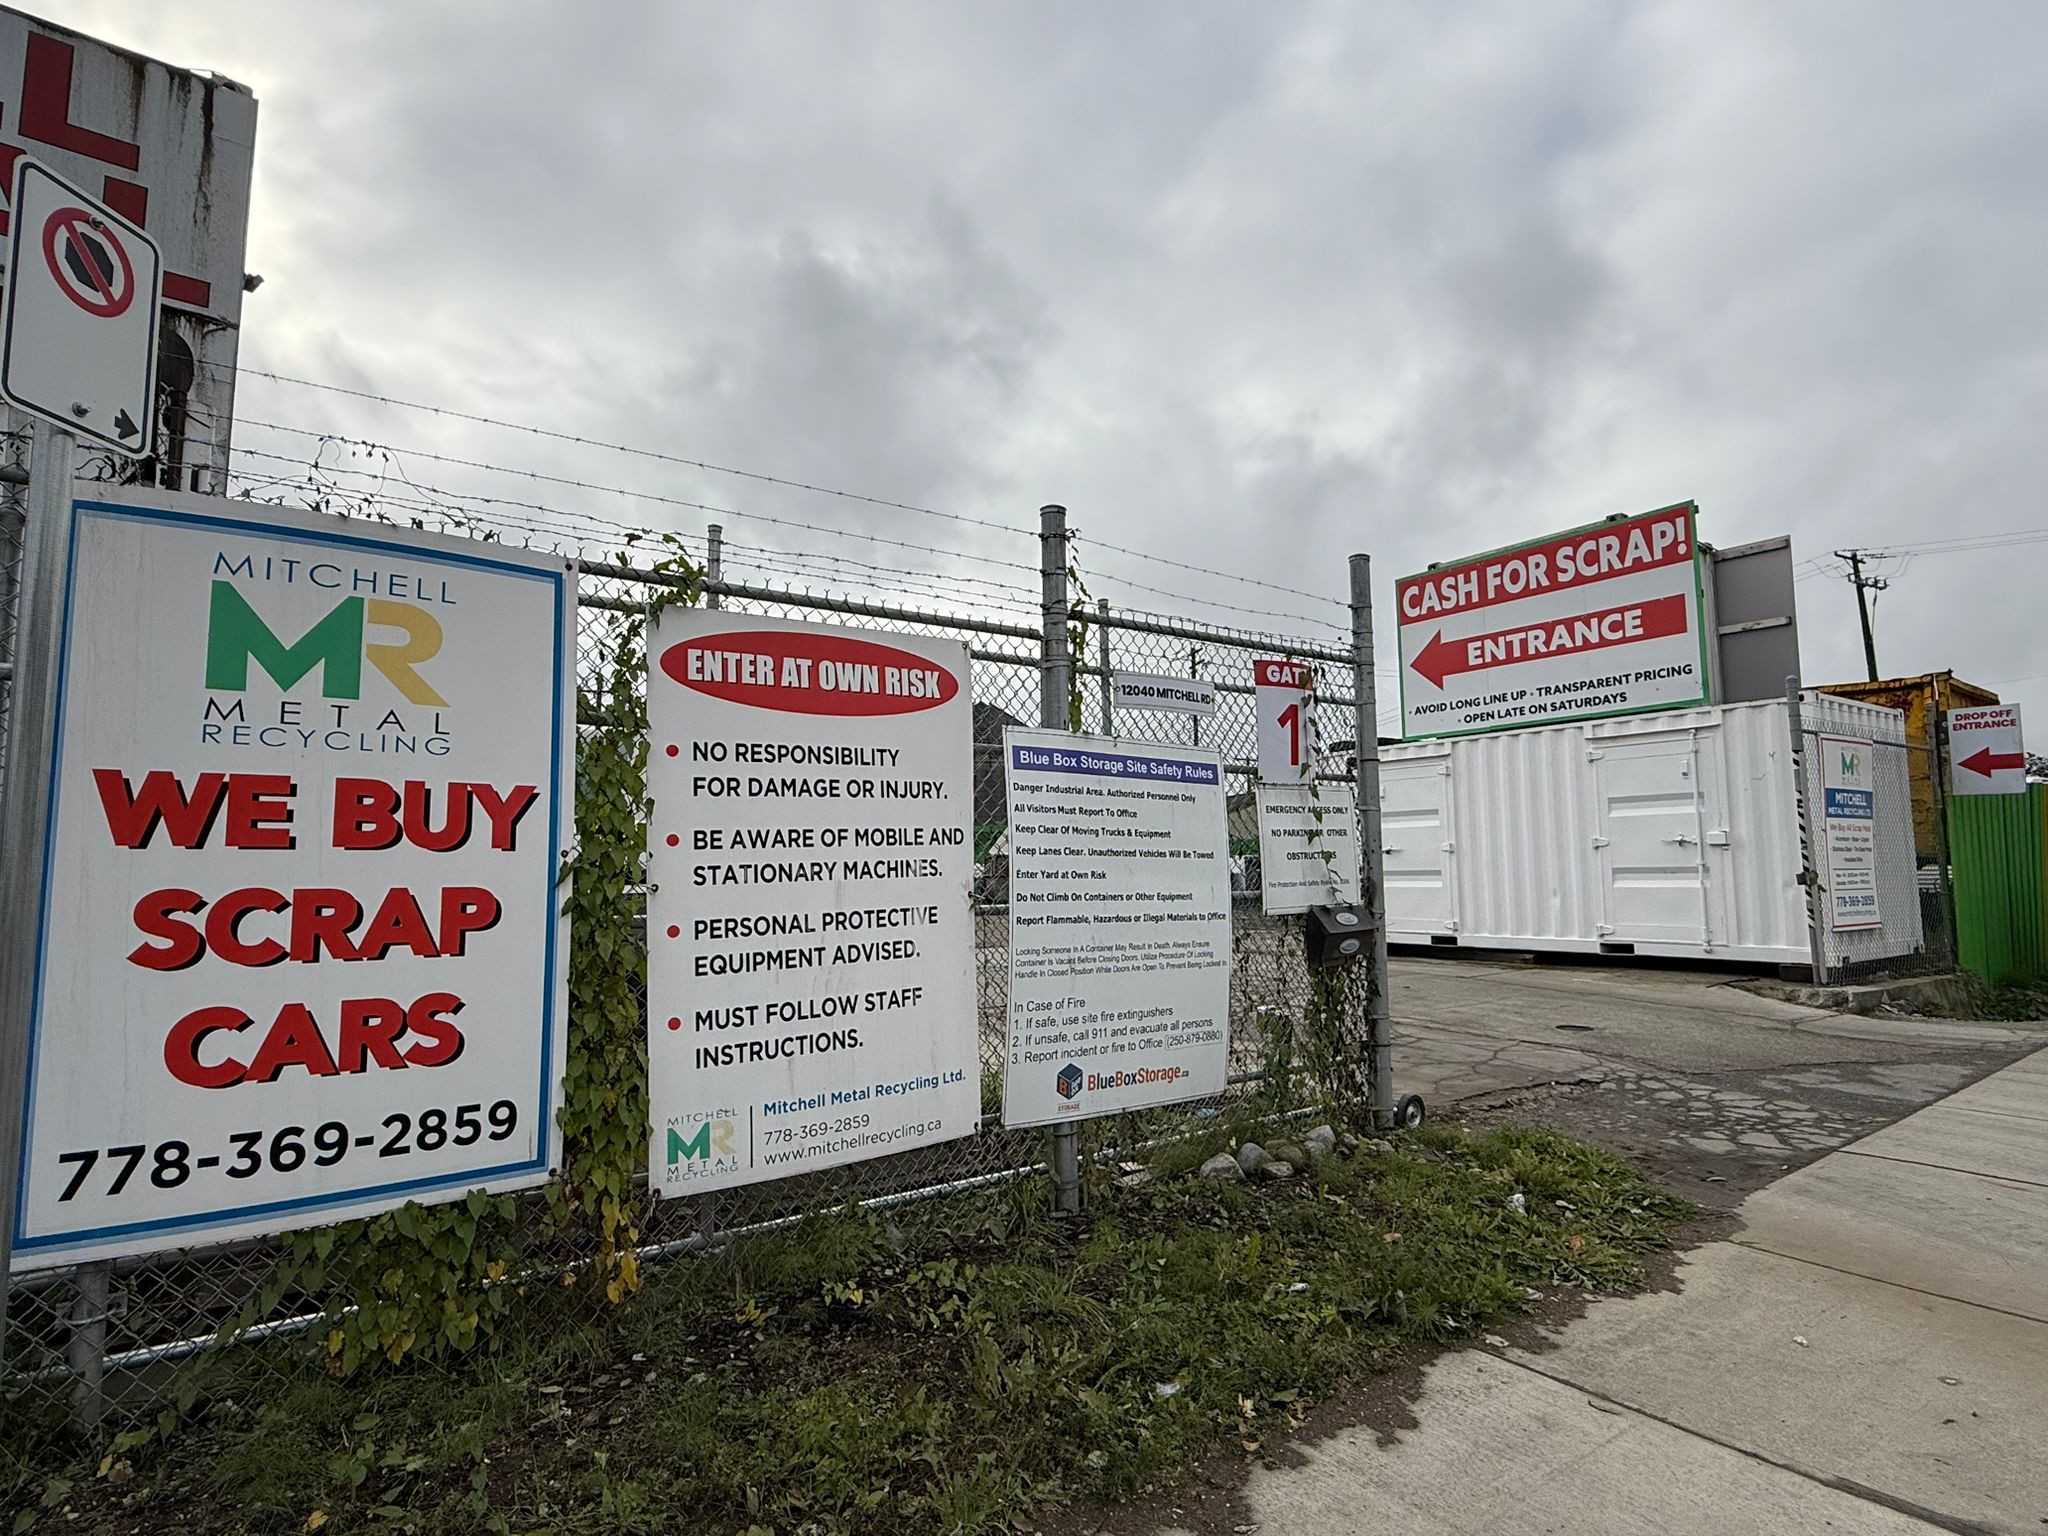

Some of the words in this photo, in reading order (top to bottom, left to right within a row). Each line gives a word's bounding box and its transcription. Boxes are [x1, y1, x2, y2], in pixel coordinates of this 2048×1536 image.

[213, 551, 456, 604] MITCHELL
[1402, 570, 1479, 618] CASH
[1487, 553, 1550, 600] FOR
[1555, 516, 1687, 583] SCRAP!
[205, 580, 451, 708] MR
[1467, 609, 1644, 666] ENTRANCE
[687, 648, 775, 687] ENTER
[781, 657, 812, 689] AT
[818, 660, 880, 694] OWN
[885, 666, 941, 699] RISK
[1266, 664, 1308, 687] GAT
[1120, 684, 1155, 697] 12040
[1156, 687, 1199, 703] MITCHELL
[1200, 694, 1211, 705] RD
[1414, 702, 1448, 717] AVOID
[1449, 697, 1481, 712] LONG
[1483, 693, 1509, 707] LINE
[1511, 690, 1527, 702] UP
[1536, 673, 1632, 698] TRANSPARENT
[1634, 664, 1693, 683] PRICING
[203, 697, 451, 735] METAL
[1464, 711, 1495, 725] OPEN
[1498, 706, 1526, 720] LATE
[1528, 703, 1548, 715] ON
[1550, 692, 1628, 712] SATURDAYS
[1955, 711, 1990, 722] DROP
[1991, 709, 2013, 719] OFF
[1277, 703, 1299, 766] 1
[1952, 718, 2017, 732] ENTRANCE
[201, 723, 451, 756] RECYCLING
[692, 742, 728, 762] NO
[735, 743, 899, 767] RESPONSIBILITY
[1020, 750, 1049, 764] Blue
[1053, 753, 1077, 767] Box
[1080, 756, 1124, 774] Storage
[1126, 760, 1148, 773] Site
[1150, 762, 1182, 779] Safety
[1185, 765, 1214, 779] Rules
[692, 777, 741, 798] FOR
[748, 778, 841, 799] DAMAGE
[846, 780, 874, 799] OR
[880, 781, 948, 800] INJURY.
[1013, 782, 1044, 794] Danger
[1045, 785, 1084, 795] Industrial
[1086, 787, 1105, 797] Area.
[1107, 788, 1144, 799] Authorized
[1147, 791, 1180, 801] Personnel
[1181, 794, 1196, 804] Only
[1835, 792, 1867, 806] MITCHELL
[92, 768, 297, 850] WE
[332, 777, 540, 852] BUY
[1014, 804, 1025, 813] All
[1026, 804, 1056, 814] Visitors
[1058, 806, 1077, 815] Must
[1079, 807, 1104, 818] Report
[1105, 808, 1115, 817] To
[1116, 809, 1138, 818] Office
[1265, 806, 1306, 814] EMERGENCY
[1332, 806, 1348, 815] ONLY
[693, 829, 723, 850] BE
[730, 828, 814, 849] AWARE
[820, 828, 849, 848] OF
[854, 828, 924, 847] MOBILE
[929, 827, 965, 846] AND
[1015, 824, 1036, 835] Keep
[1038, 825, 1059, 834] Clear
[1061, 826, 1070, 834] Of
[1071, 826, 1099, 837] Moving
[1101, 827, 1125, 836] Trucks
[1134, 829, 1171, 839] Equipment
[1271, 829, 1281, 837] NO
[1327, 829, 1347, 837] OTHER
[1016, 846, 1036, 857] Keep
[1039, 846, 1062, 856] Lanes
[1063, 847, 1086, 856] Clear.
[1088, 848, 1136, 857] Unauthorized
[1138, 849, 1167, 858] Vehicles
[1168, 850, 1181, 858] Will
[1192, 851, 1214, 859] Towed
[693, 861, 837, 886] STATIONARY
[843, 859, 943, 881] MACHINES.
[1016, 869, 1038, 879] Enter
[1040, 870, 1059, 879] Yard
[1071, 871, 1089, 879] Own
[1090, 871, 1107, 879] Risk
[1016, 893, 1028, 902] Do
[1030, 893, 1045, 902] Not
[1046, 892, 1069, 902] Climb
[1071, 893, 1082, 901] On
[1084, 892, 1124, 902] Containers
[1135, 892, 1155, 901] Other
[1156, 892, 1193, 902] Equipment
[126, 886, 501, 972] SCRAP
[694, 912, 816, 941] PERSONAL
[822, 906, 938, 932] PROTECTIVE
[1016, 916, 1044, 927] Report
[1046, 915, 1091, 925] Flammable,
[1093, 914, 1132, 923] Hazardous
[1143, 913, 1165, 923] Illegal
[1167, 912, 1198, 921] Materials
[1207, 912, 1226, 921] Office
[694, 947, 826, 977] EQUIPMENT
[832, 939, 921, 965] ADVISED.
[695, 1005, 759, 1032] MUST
[766, 994, 858, 1024] FOLLOW
[864, 987, 923, 1013] STAFF
[1014, 1002, 1023, 1013] In
[1026, 1000, 1053, 1012] Case
[1055, 998, 1066, 1009] of
[1067, 997, 1086, 1009] Fire
[1035, 1015, 1059, 1028] safe,
[1062, 1016, 1079, 1026] use
[1082, 1013, 1098, 1024] site
[1100, 1011, 1115, 1022] fire
[1117, 1006, 1173, 1021] extinguishers
[163, 992, 466, 1089] CARS
[1034, 1031, 1070, 1045] unsafe,
[1073, 1029, 1089, 1041] call
[1091, 1027, 1107, 1039] 911
[1111, 1025, 1127, 1037] and
[1130, 1021, 1168, 1035] evacuate
[1170, 1020, 1179, 1030] all
[1181, 1019, 1213, 1032] persons
[695, 1029, 864, 1069] INSTRUCTIONS.
[1024, 1049, 1058, 1064] Report
[1061, 1045, 1097, 1059] incident
[1100, 1044, 1109, 1055] or
[1112, 1042, 1125, 1053] fire
[1139, 1037, 1163, 1049] Office
[1088, 1066, 1189, 1091] BlueBoxStorage.ca
[763, 1093, 826, 1117] Mitchell
[831, 1087, 871, 1111] Metal
[876, 1076, 939, 1101] Recycling
[943, 1069, 966, 1086] Ltd.
[667, 1107, 739, 1126] MITCHELL
[763, 1114, 870, 1146] 778-369-2859
[57, 1099, 518, 1202] 778-369-2859
[667, 1119, 738, 1166] MR
[764, 1118, 942, 1166] www.mitchellrecycling.ca
[667, 1155, 738, 1176] METAL
[667, 1165, 739, 1184] RECYCLING
